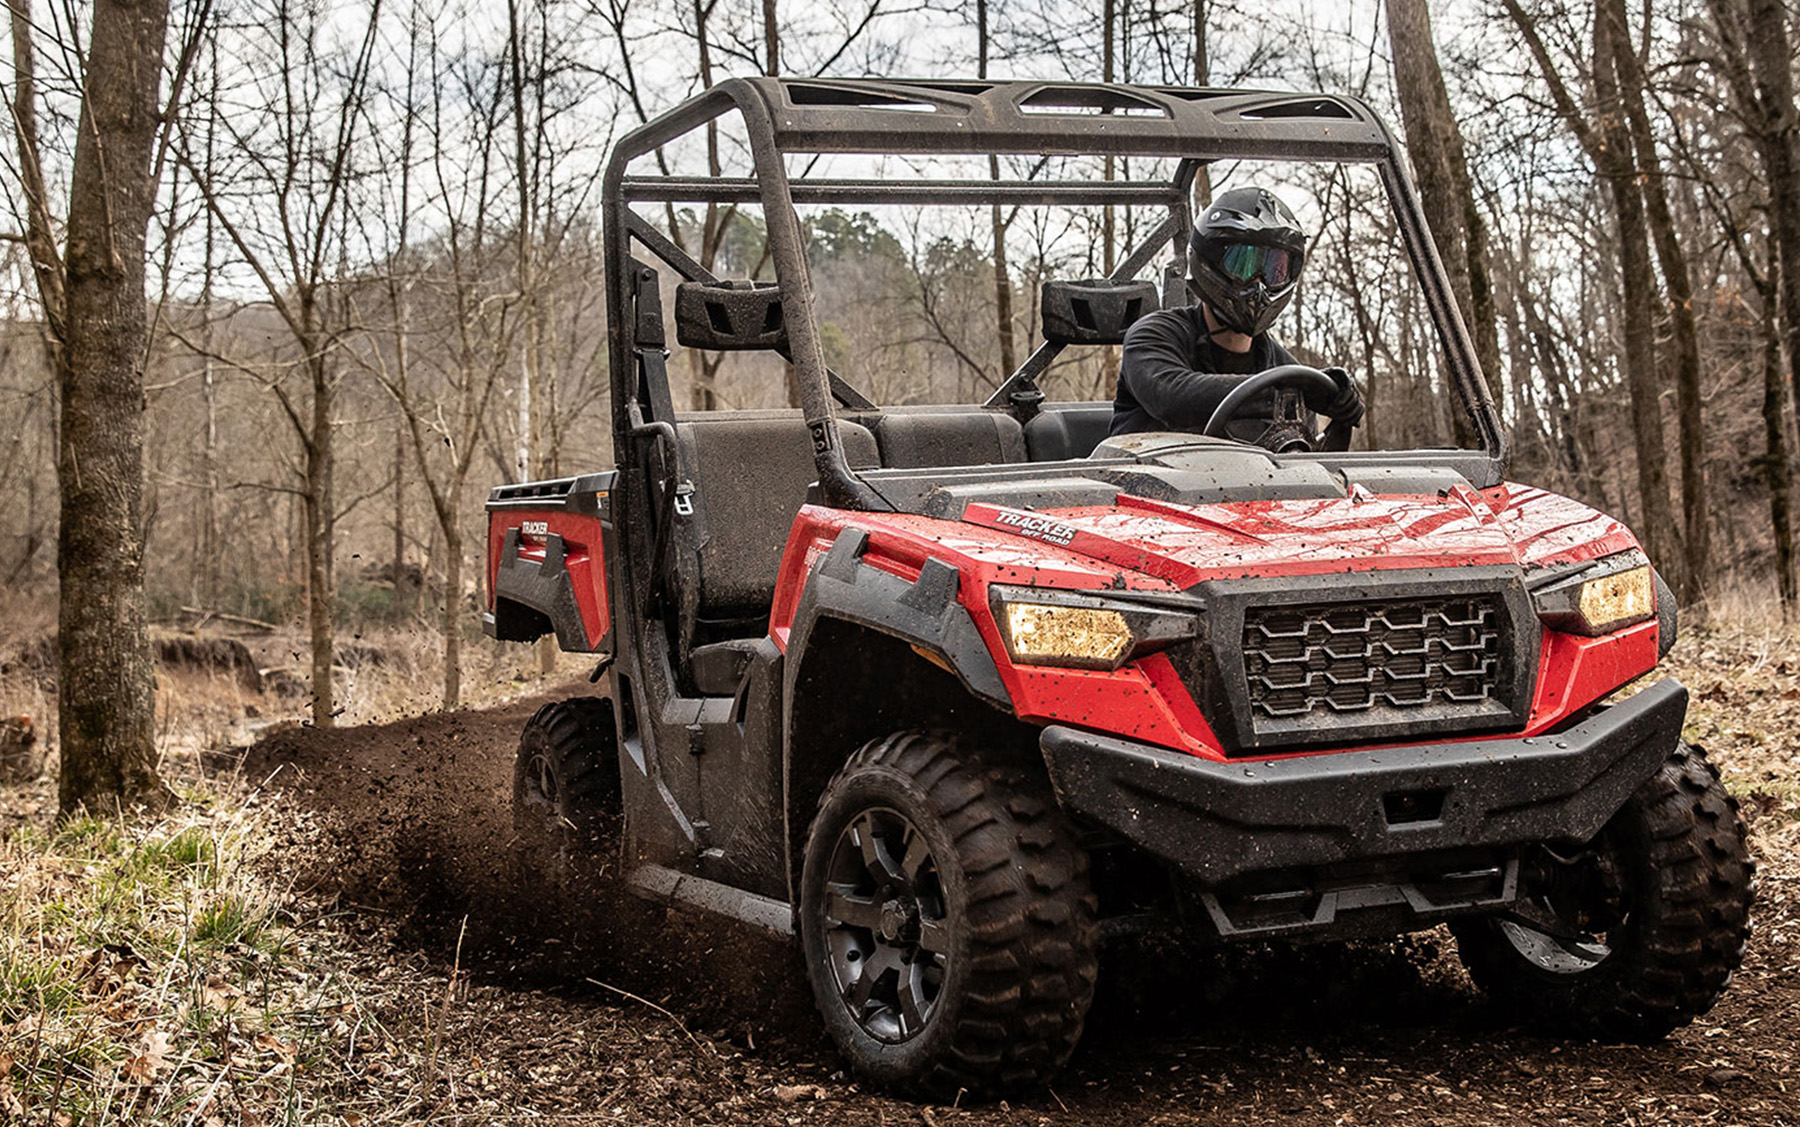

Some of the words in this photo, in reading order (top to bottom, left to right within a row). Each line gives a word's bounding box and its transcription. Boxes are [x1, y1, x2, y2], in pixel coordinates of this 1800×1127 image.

[996, 511, 1076, 539] TRACKER
[1021, 528, 1041, 538] OFF
[1041, 533, 1070, 546] ROAD
